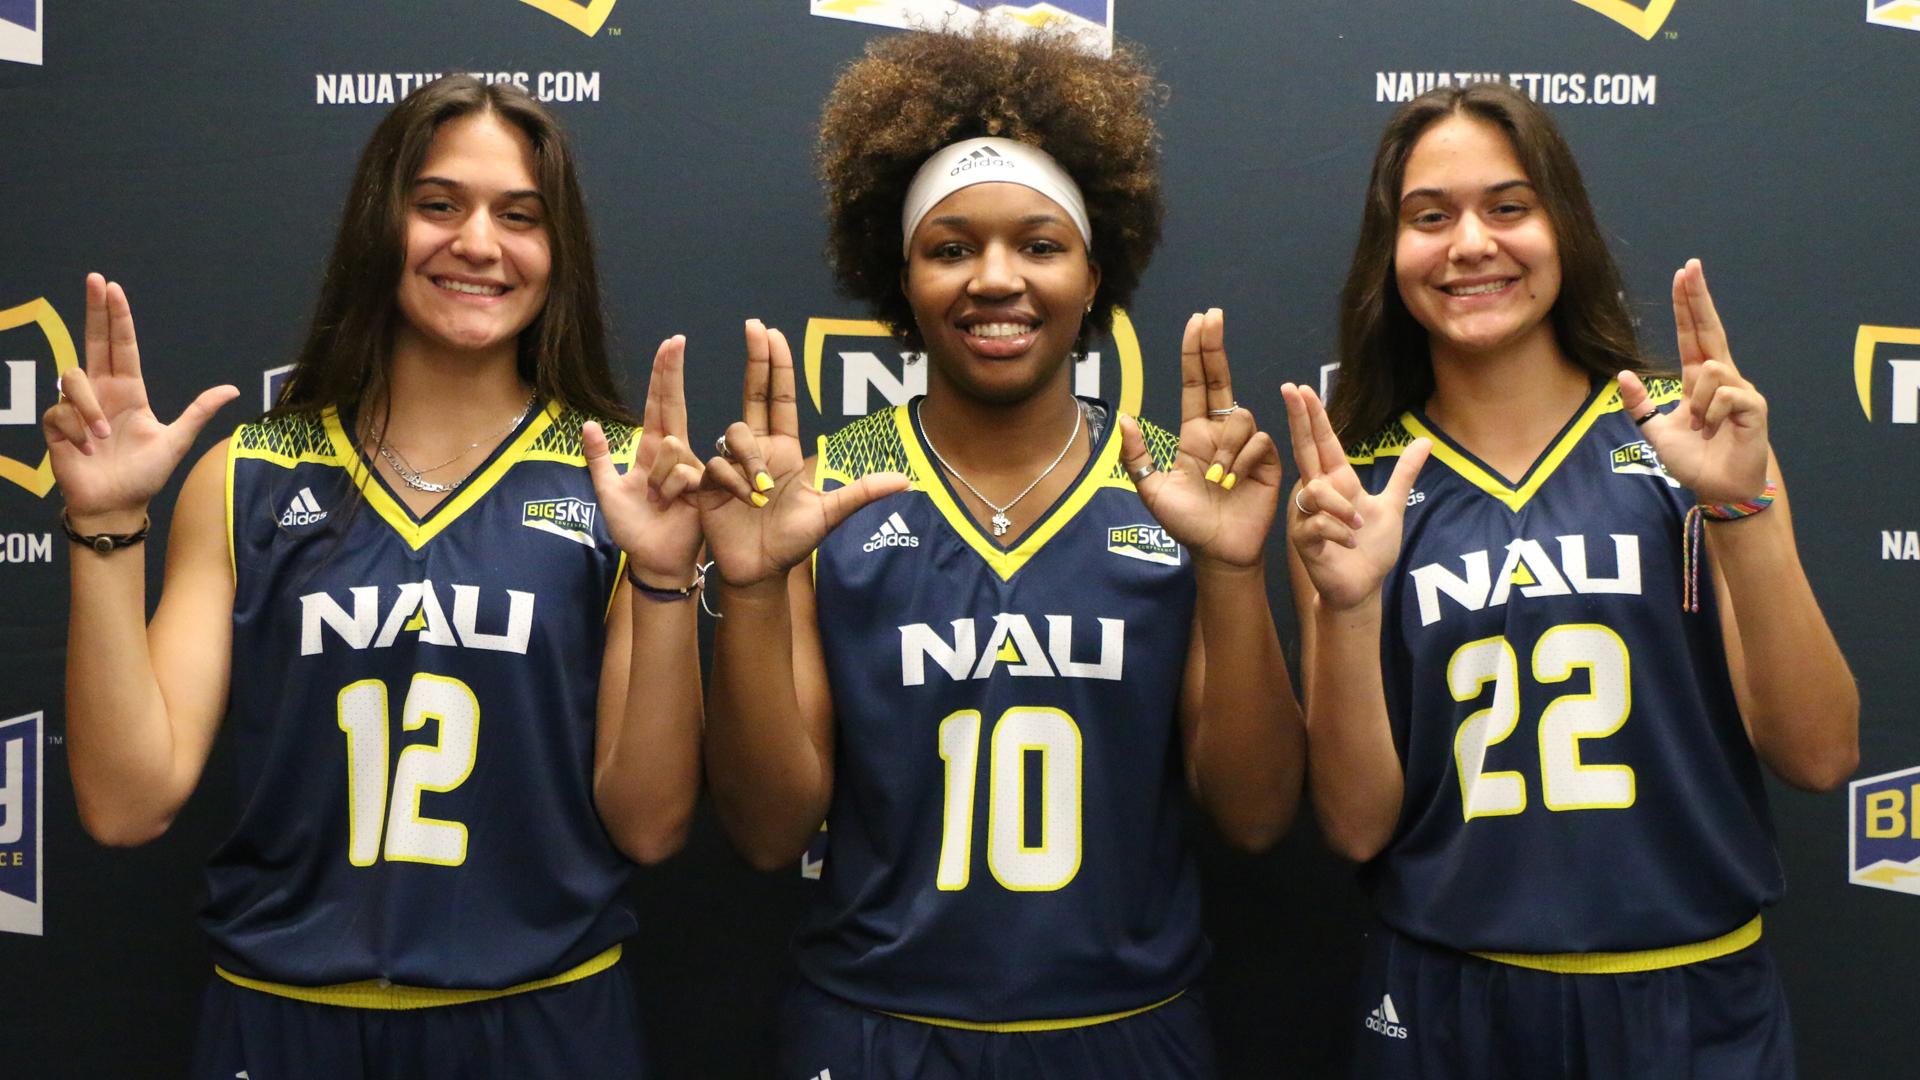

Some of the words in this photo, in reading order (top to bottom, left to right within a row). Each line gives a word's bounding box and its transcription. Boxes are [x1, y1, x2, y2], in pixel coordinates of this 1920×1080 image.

[950, 157, 1015, 176] adidas
[862, 532, 919, 553] adidas
[1408, 533, 1642, 627] NAU
[299, 579, 535, 656] NAU
[897, 612, 1125, 686] NAU
[1446, 623, 1636, 824] 22
[336, 672, 481, 867] 12
[936, 705, 1083, 892] 10
